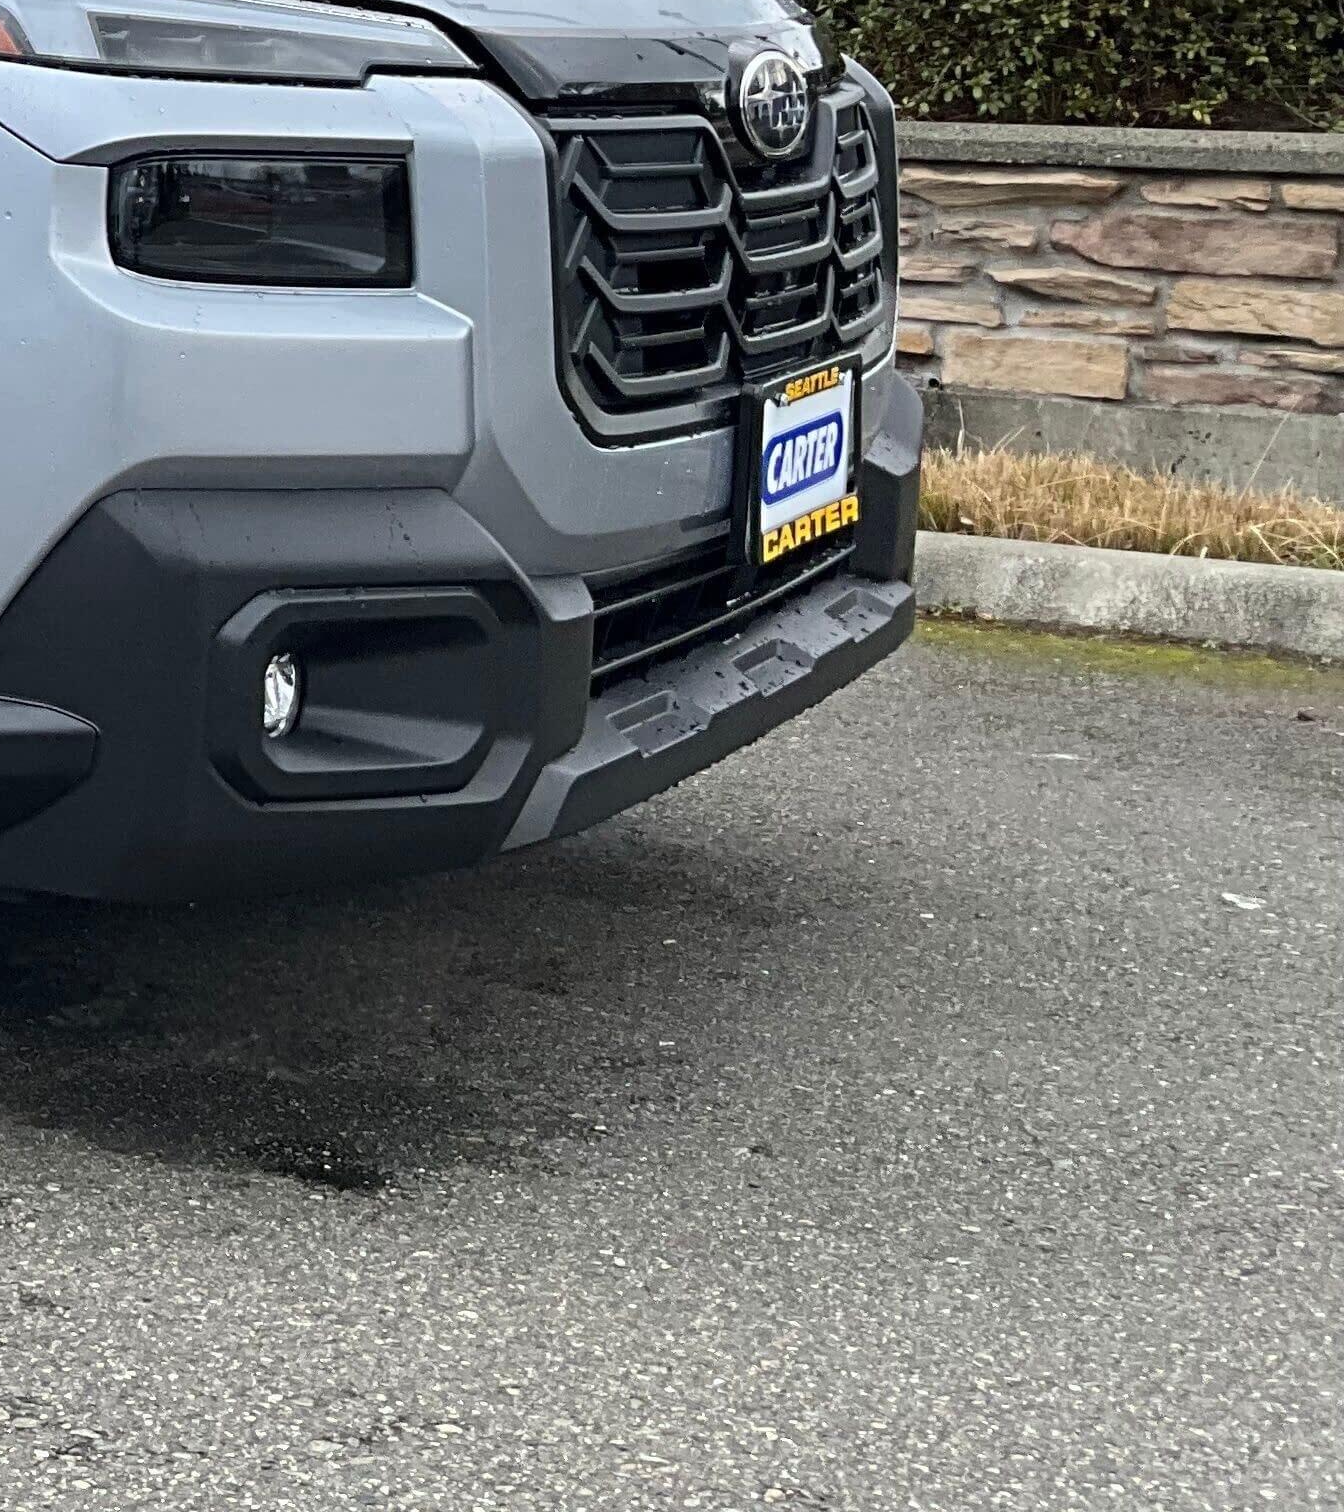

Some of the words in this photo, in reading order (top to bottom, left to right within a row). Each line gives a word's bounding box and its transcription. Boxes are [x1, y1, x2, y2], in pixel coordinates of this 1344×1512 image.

[785, 366, 841, 402] SEATTLE
[766, 420, 839, 495] CARTER
[763, 495, 860, 563] CARTER
